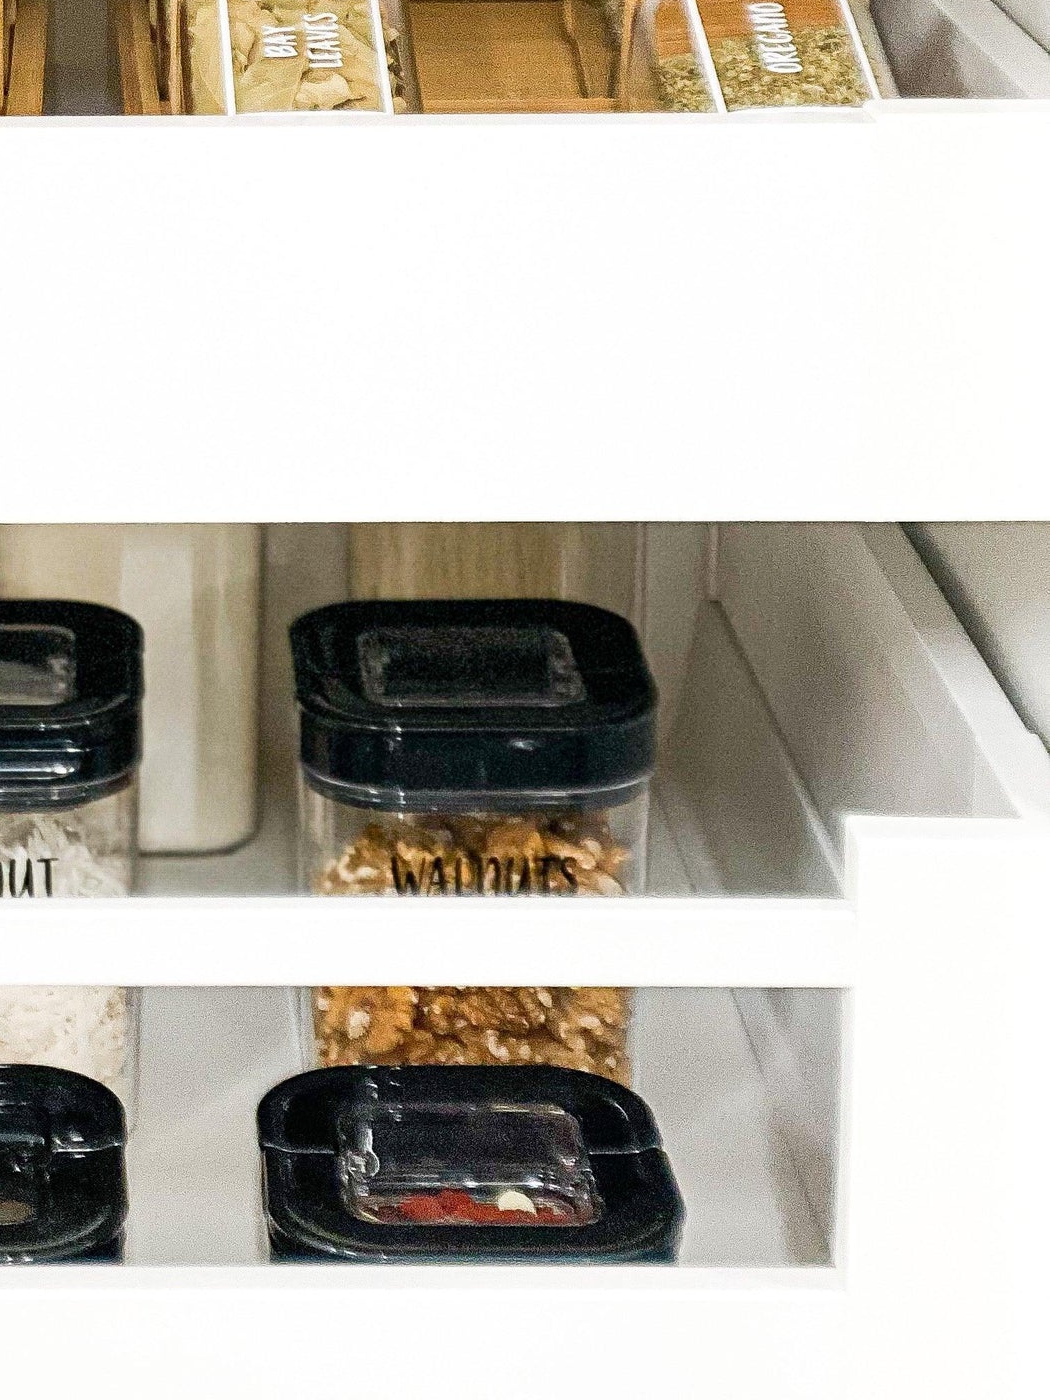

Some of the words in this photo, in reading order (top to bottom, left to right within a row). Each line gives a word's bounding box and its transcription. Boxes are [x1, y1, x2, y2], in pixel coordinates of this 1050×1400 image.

[261, 25, 299, 59] BAY
[303, 12, 344, 69] LEAVES
[749, 1, 803, 74] OREGANO
[391, 854, 580, 897] WALNUTS
